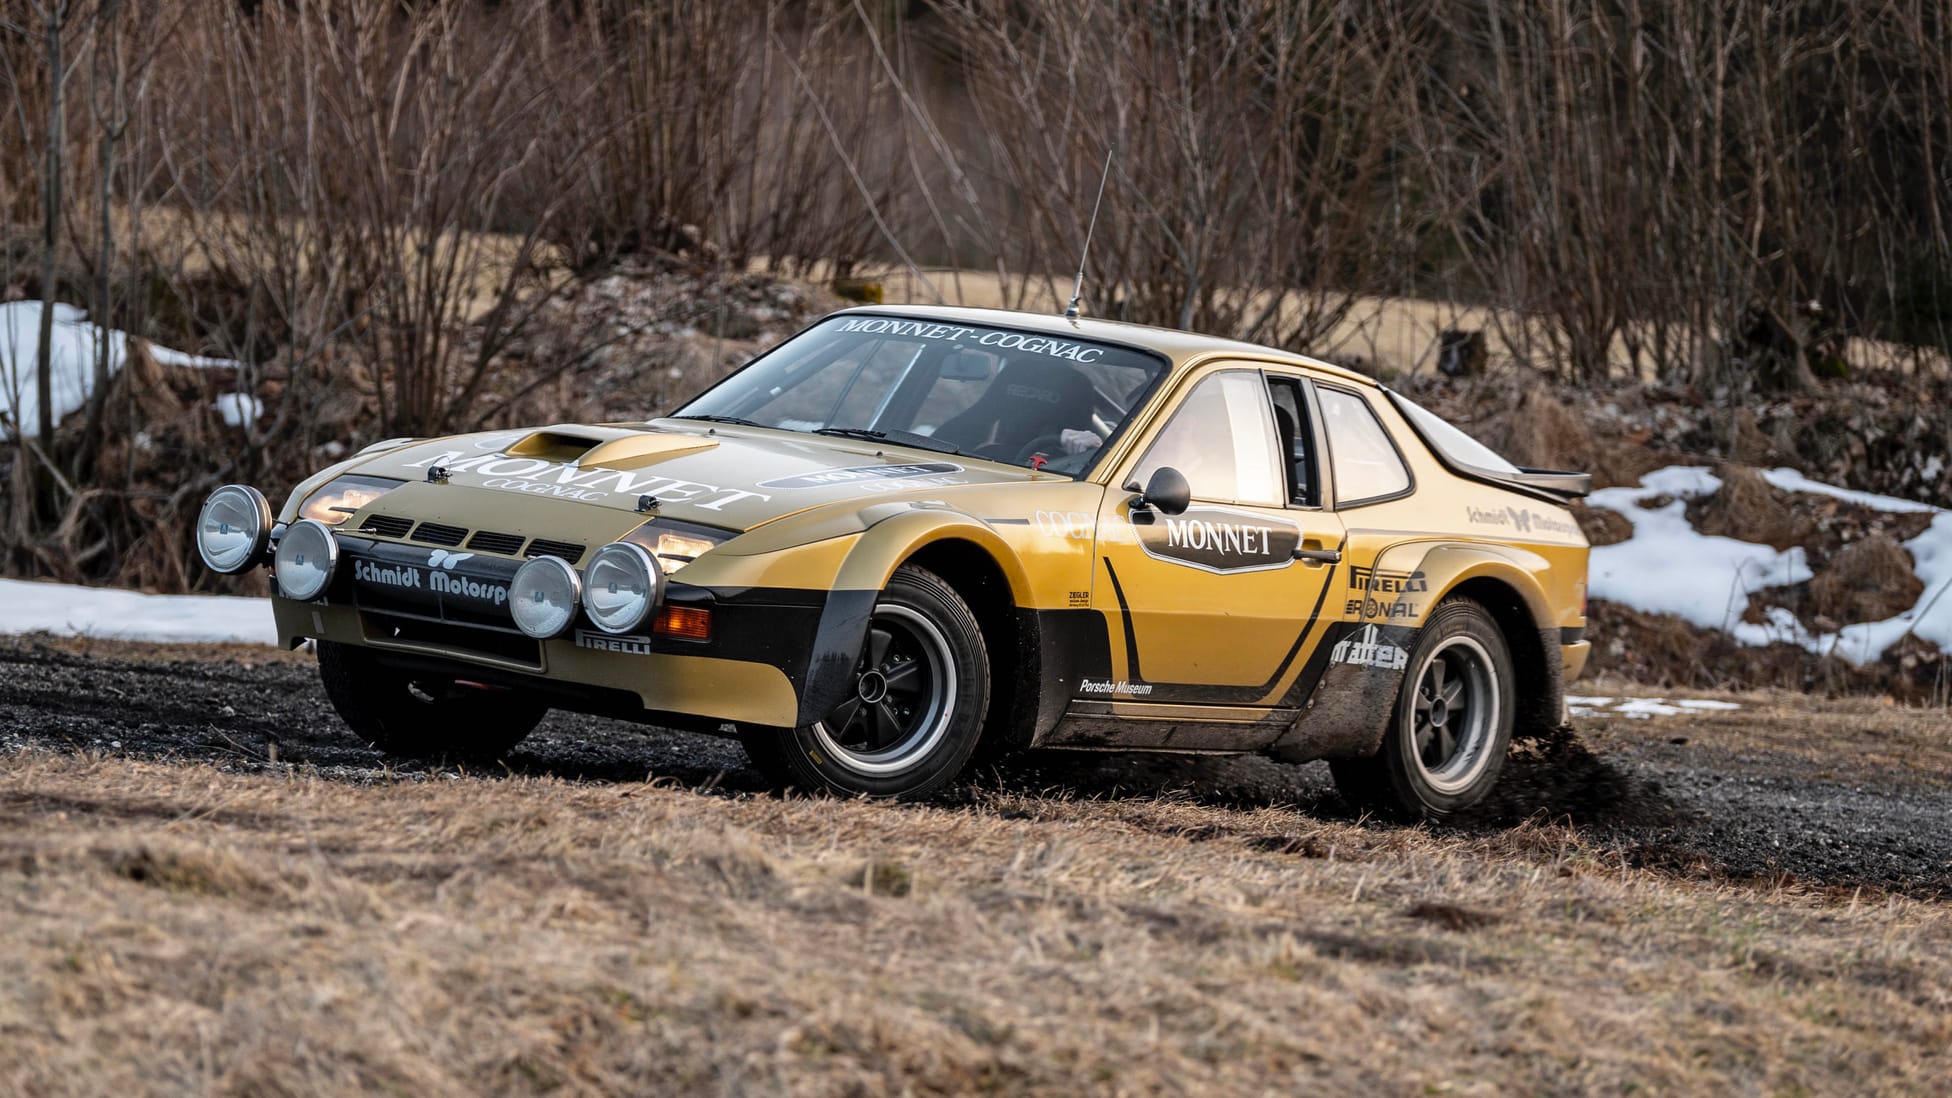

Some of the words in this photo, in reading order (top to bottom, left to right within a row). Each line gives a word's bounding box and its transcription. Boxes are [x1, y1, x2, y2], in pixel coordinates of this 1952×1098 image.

[835, 318, 1104, 364] MONNET-COGNAC
[402, 450, 772, 512] MONNET
[482, 477, 608, 501] COGNAC
[1165, 518, 1274, 556] MONNET
[354, 559, 421, 589] Schmidt
[1350, 564, 1428, 593] PIRELLI
[1345, 598, 1420, 619] RONAL
[575, 628, 652, 656] PIRELLI
[1080, 679, 1115, 693] Porsche
[1114, 681, 1153, 695] Museum
